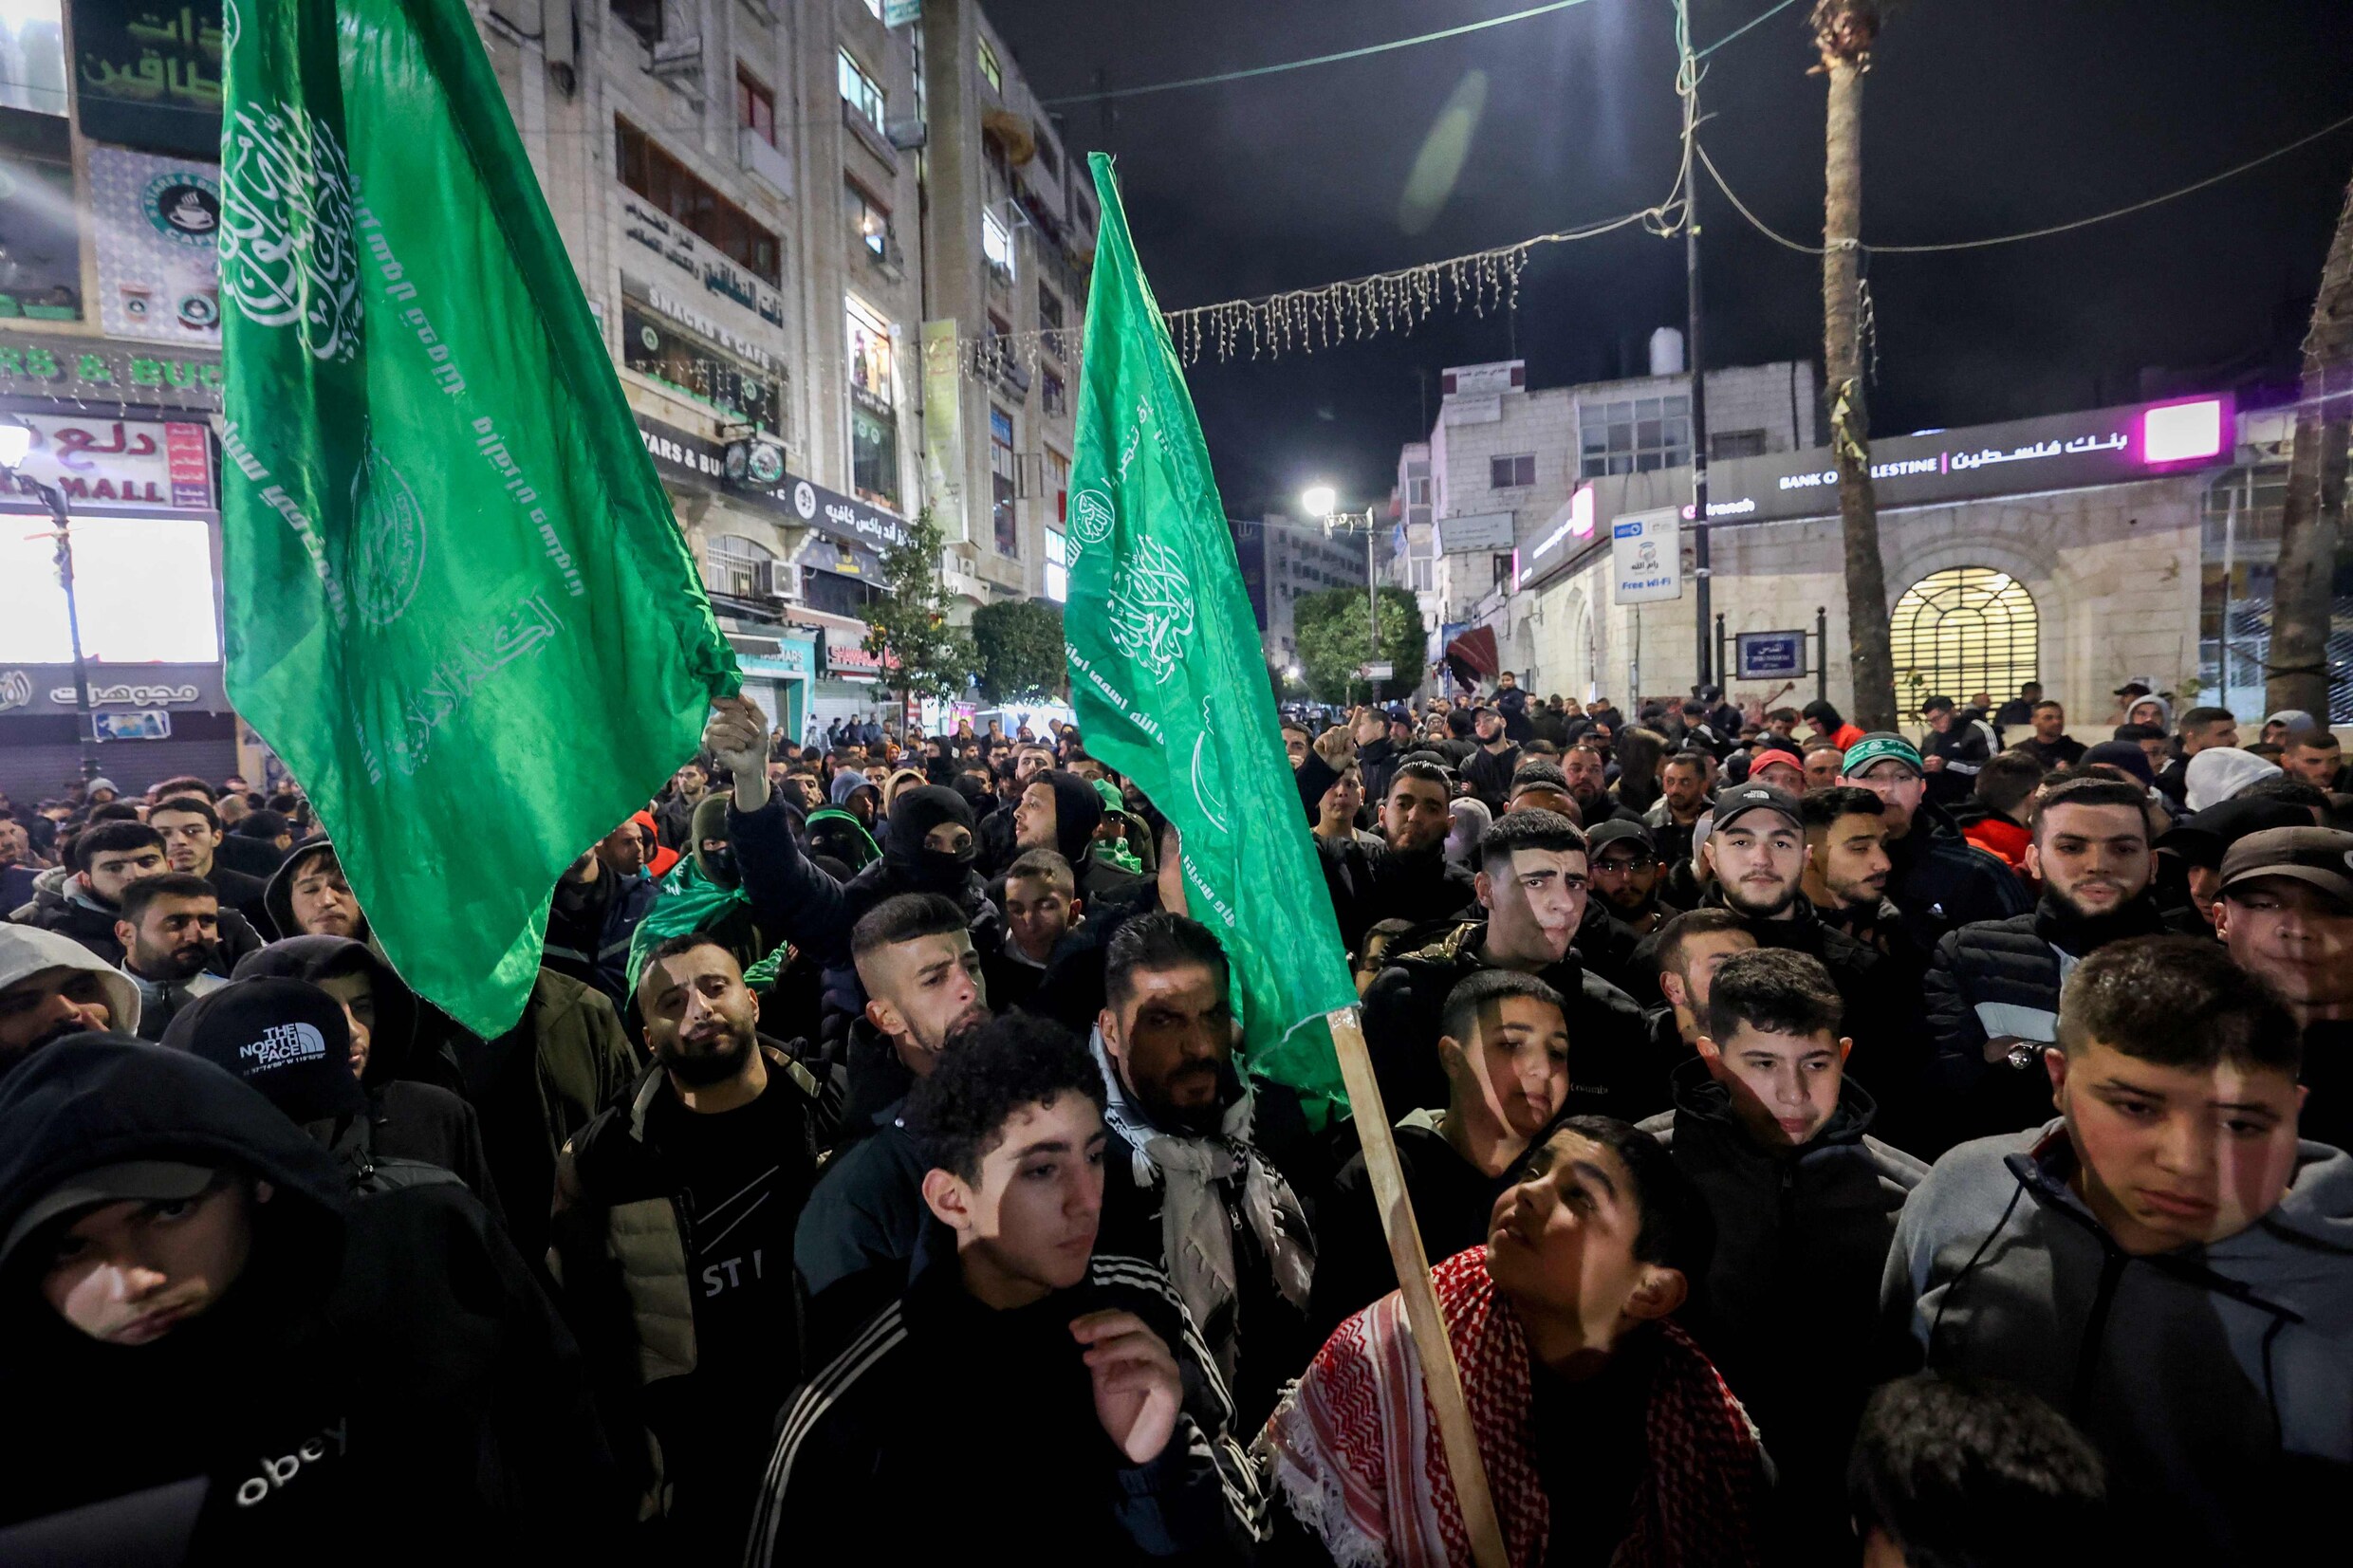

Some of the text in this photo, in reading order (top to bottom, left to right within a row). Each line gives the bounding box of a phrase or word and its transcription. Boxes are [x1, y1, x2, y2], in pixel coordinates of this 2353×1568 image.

[684, 448, 697, 470] &
[1951, 433, 2128, 470] بنك فلسطين
[1779, 457, 1938, 490] BANK O LESTINE
[59, 476, 165, 503] MALL
[1622, 581, 1644, 590] Free
[263, 1024, 296, 1041] THE
[239, 1033, 300, 1059] NORTH
[258, 1044, 301, 1064] FACE
[236, 1416, 347, 1506] obey
